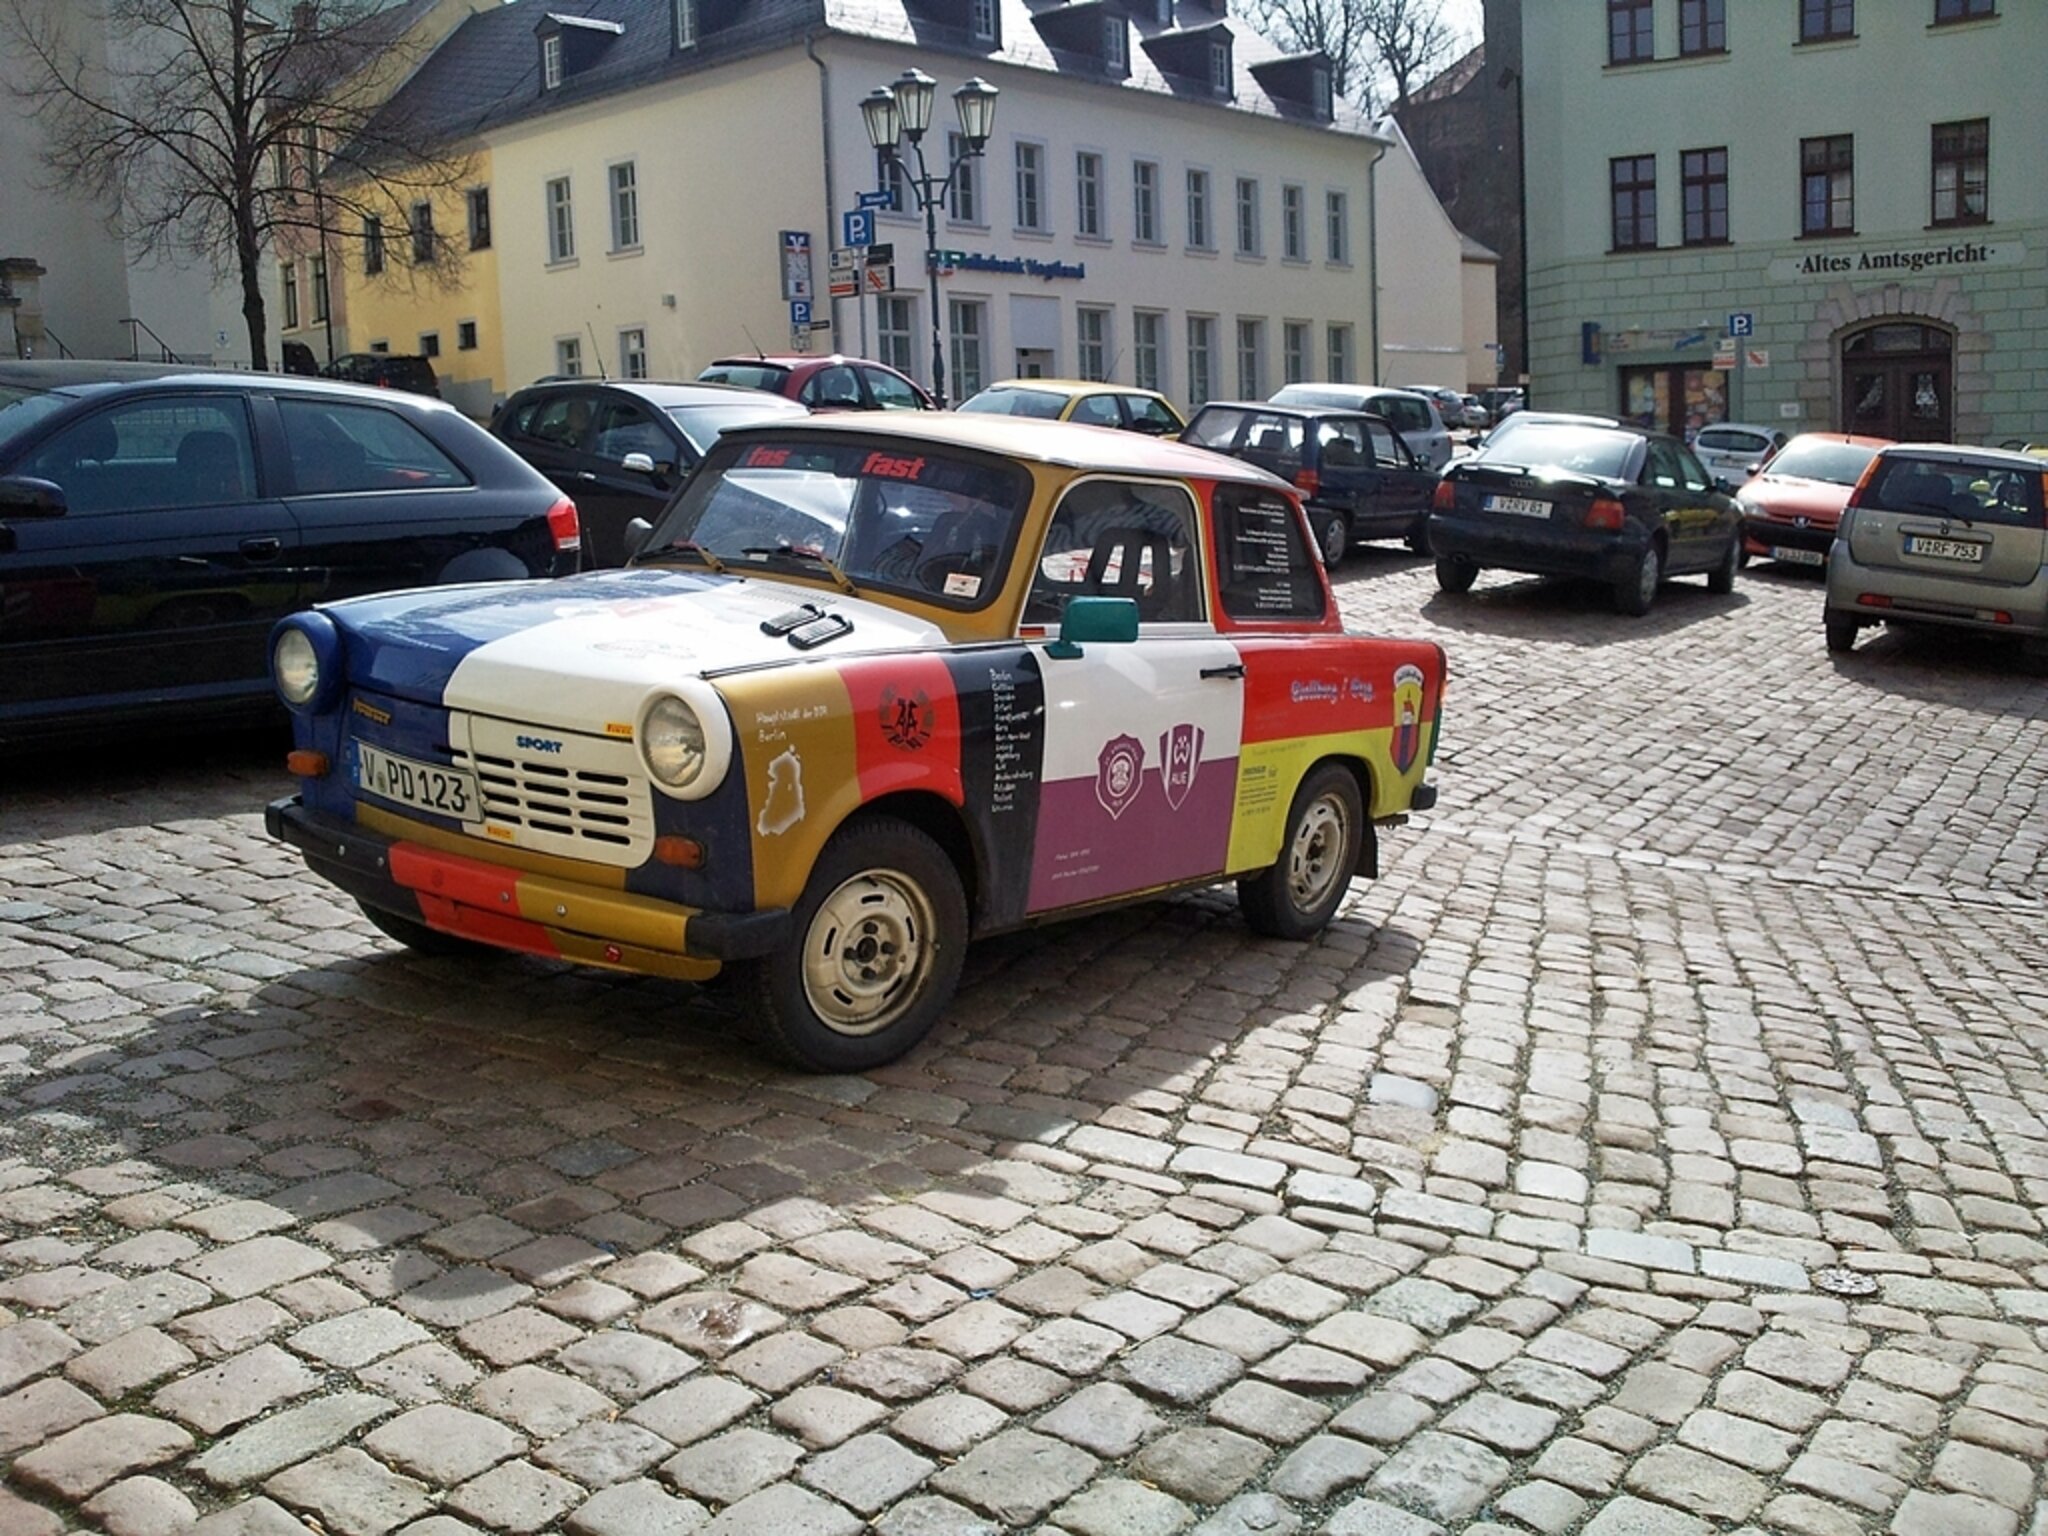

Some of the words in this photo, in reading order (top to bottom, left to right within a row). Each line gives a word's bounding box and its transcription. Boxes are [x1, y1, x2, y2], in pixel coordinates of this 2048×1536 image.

[850, 215, 865, 243] P
[962, 253, 1025, 274] olksbank
[1802, 254, 1851, 274] Altes
[1858, 243, 1986, 272] Amtsgericht
[795, 303, 807, 321] P
[1733, 315, 1748, 335] P
[861, 450, 925, 481] fast
[1953, 544, 1977, 559] 753
[516, 735, 563, 753] SPORT
[363, 750, 375, 787] V
[386, 759, 415, 801] PD
[418, 770, 466, 813] 123
